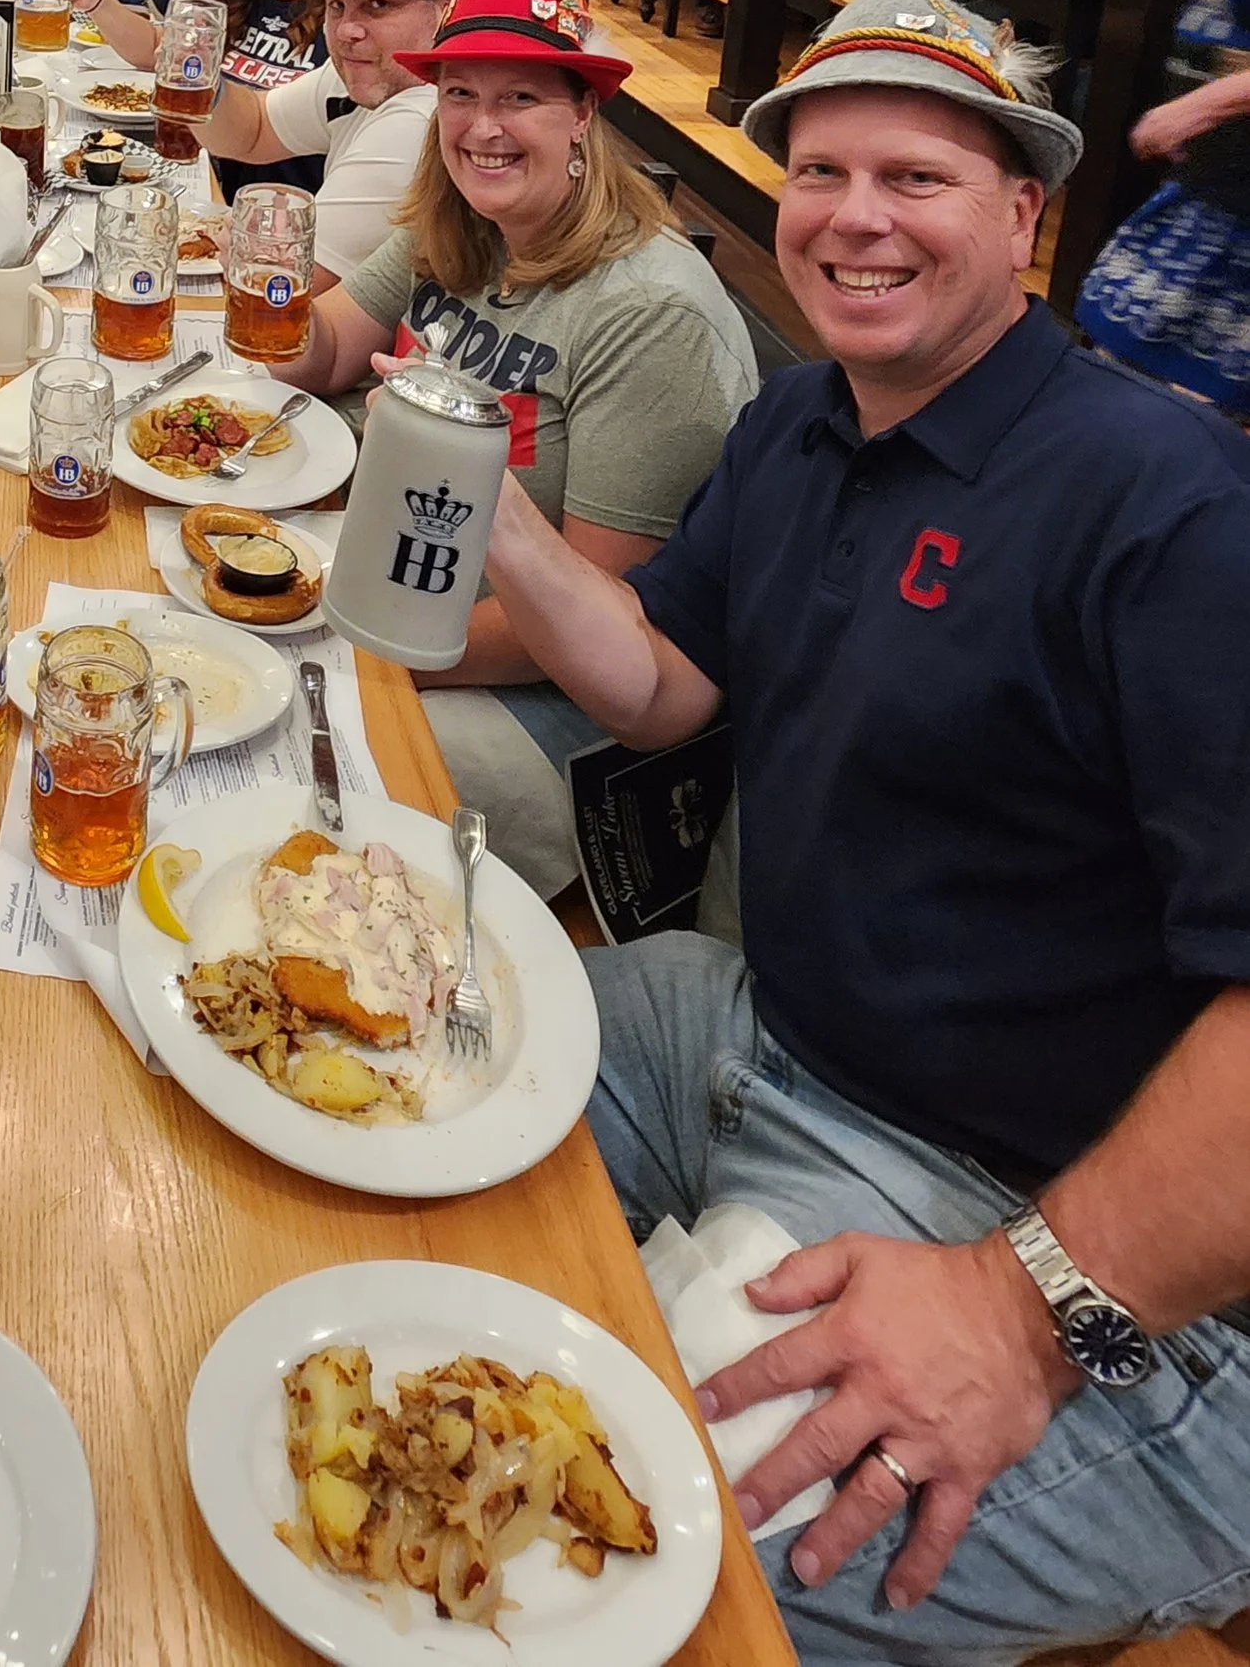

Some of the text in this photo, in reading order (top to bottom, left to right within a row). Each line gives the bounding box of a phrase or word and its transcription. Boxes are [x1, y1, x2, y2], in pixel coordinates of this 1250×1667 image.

[271, 289, 288, 302] HB
[58, 468, 75, 481] HB
[387, 530, 460, 594] HB
[898, 527, 962, 611] C
